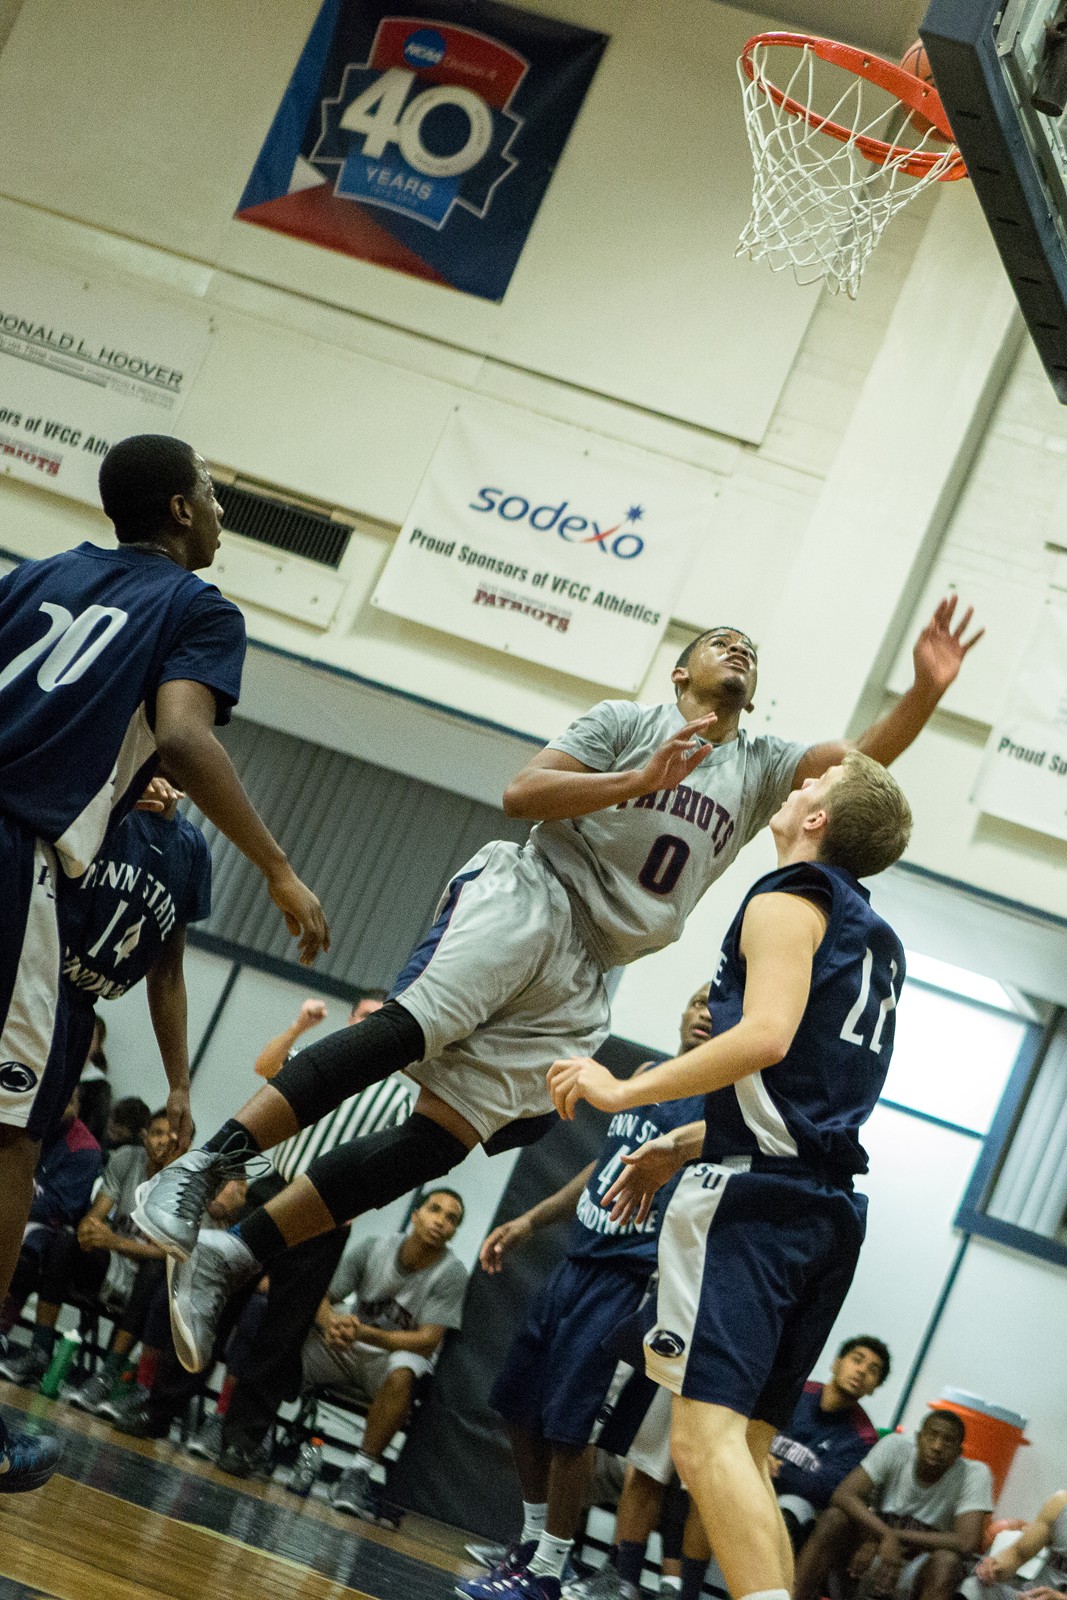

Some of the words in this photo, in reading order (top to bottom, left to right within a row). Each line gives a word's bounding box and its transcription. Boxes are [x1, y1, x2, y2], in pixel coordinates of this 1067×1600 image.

[339, 66, 494, 178] 40
[366, 165, 434, 201] YEARS
[0, 312, 75, 351] ONALD
[99, 346, 184, 387] HOOVER
[24, 417, 42, 433] of
[43, 420, 82, 448] VFCC
[468, 486, 645, 560] sodexo
[408, 528, 456, 558] Proud
[457, 545, 528, 585] Sponsors
[531, 572, 550, 589] of
[551, 575, 591, 603] VFCC
[592, 590, 661, 626] Athletics
[472, 588, 571, 634] PATRIOTS
[0, 601, 129, 692] 20
[997, 736, 1047, 768] Proud
[637, 833, 691, 895] 0
